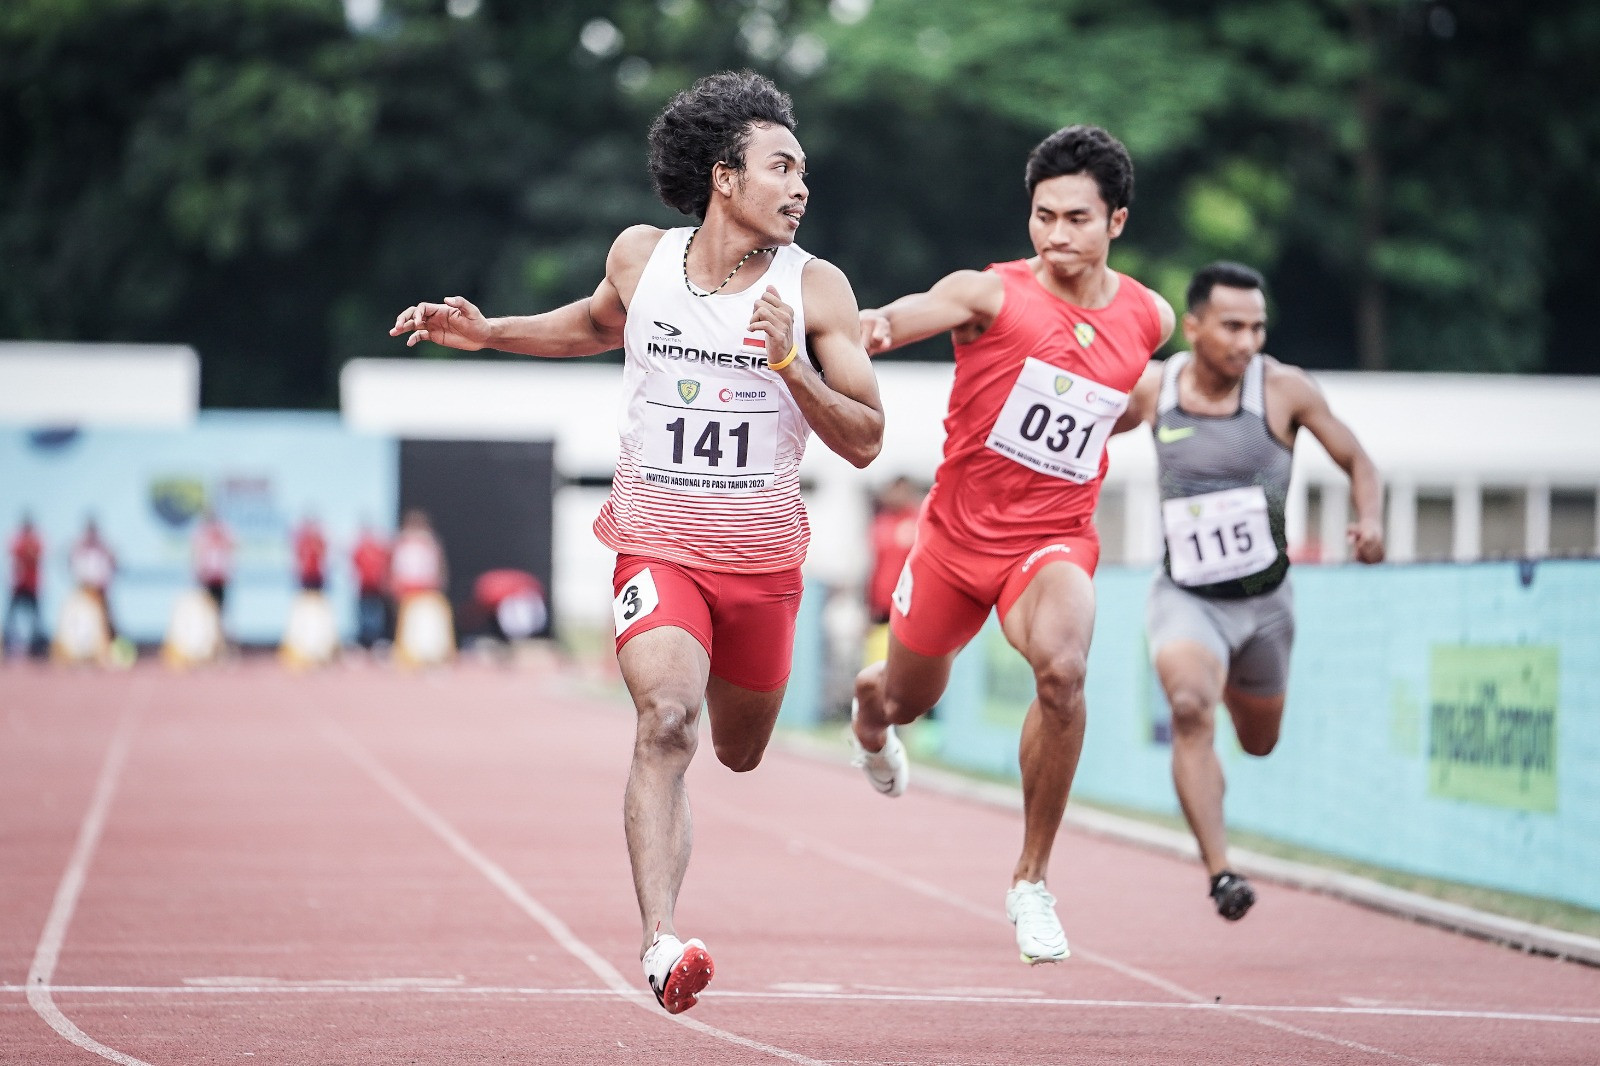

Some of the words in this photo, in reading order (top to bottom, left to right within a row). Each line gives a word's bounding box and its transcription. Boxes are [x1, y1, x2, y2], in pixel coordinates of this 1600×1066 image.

[735, 391, 757, 399] MIND
[666, 417, 750, 468] 141
[1020, 403, 1096, 459] 031
[646, 472, 670, 484] INVITASI
[670, 476, 701, 488] NASIONAL
[701, 479, 711, 488] PB
[711, 480, 727, 489] PASI
[728, 480, 748, 489] TAHUN
[748, 479, 765, 488] 2023
[1188, 521, 1253, 562] 115
[622, 585, 643, 620] 3
